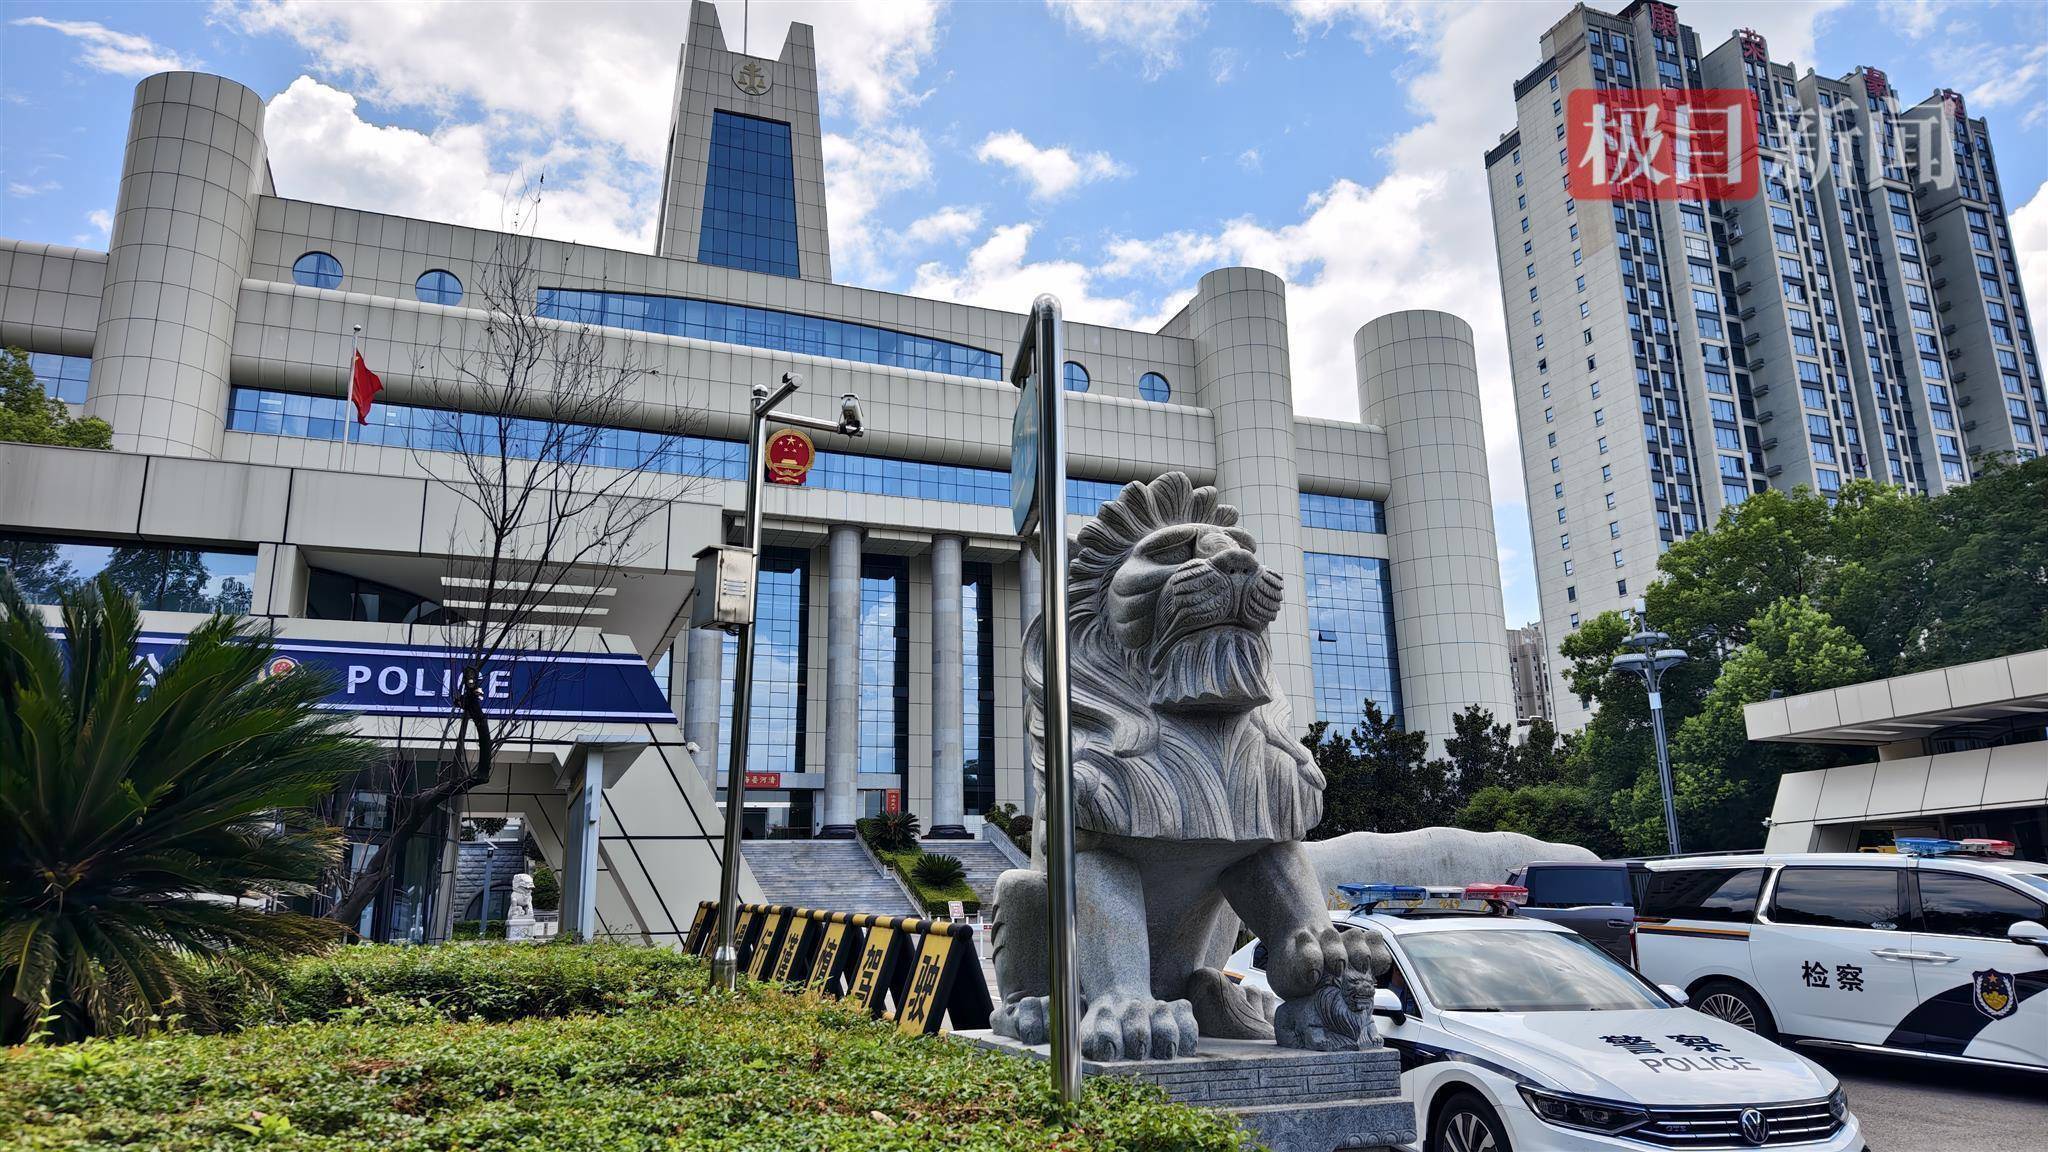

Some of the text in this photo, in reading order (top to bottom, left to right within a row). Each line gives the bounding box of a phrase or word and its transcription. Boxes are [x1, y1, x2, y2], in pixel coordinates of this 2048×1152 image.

[1801, 960, 1865, 992] 检察
[1598, 1034, 1731, 1055] 警察
[1639, 1056, 1763, 1073] POLICE
